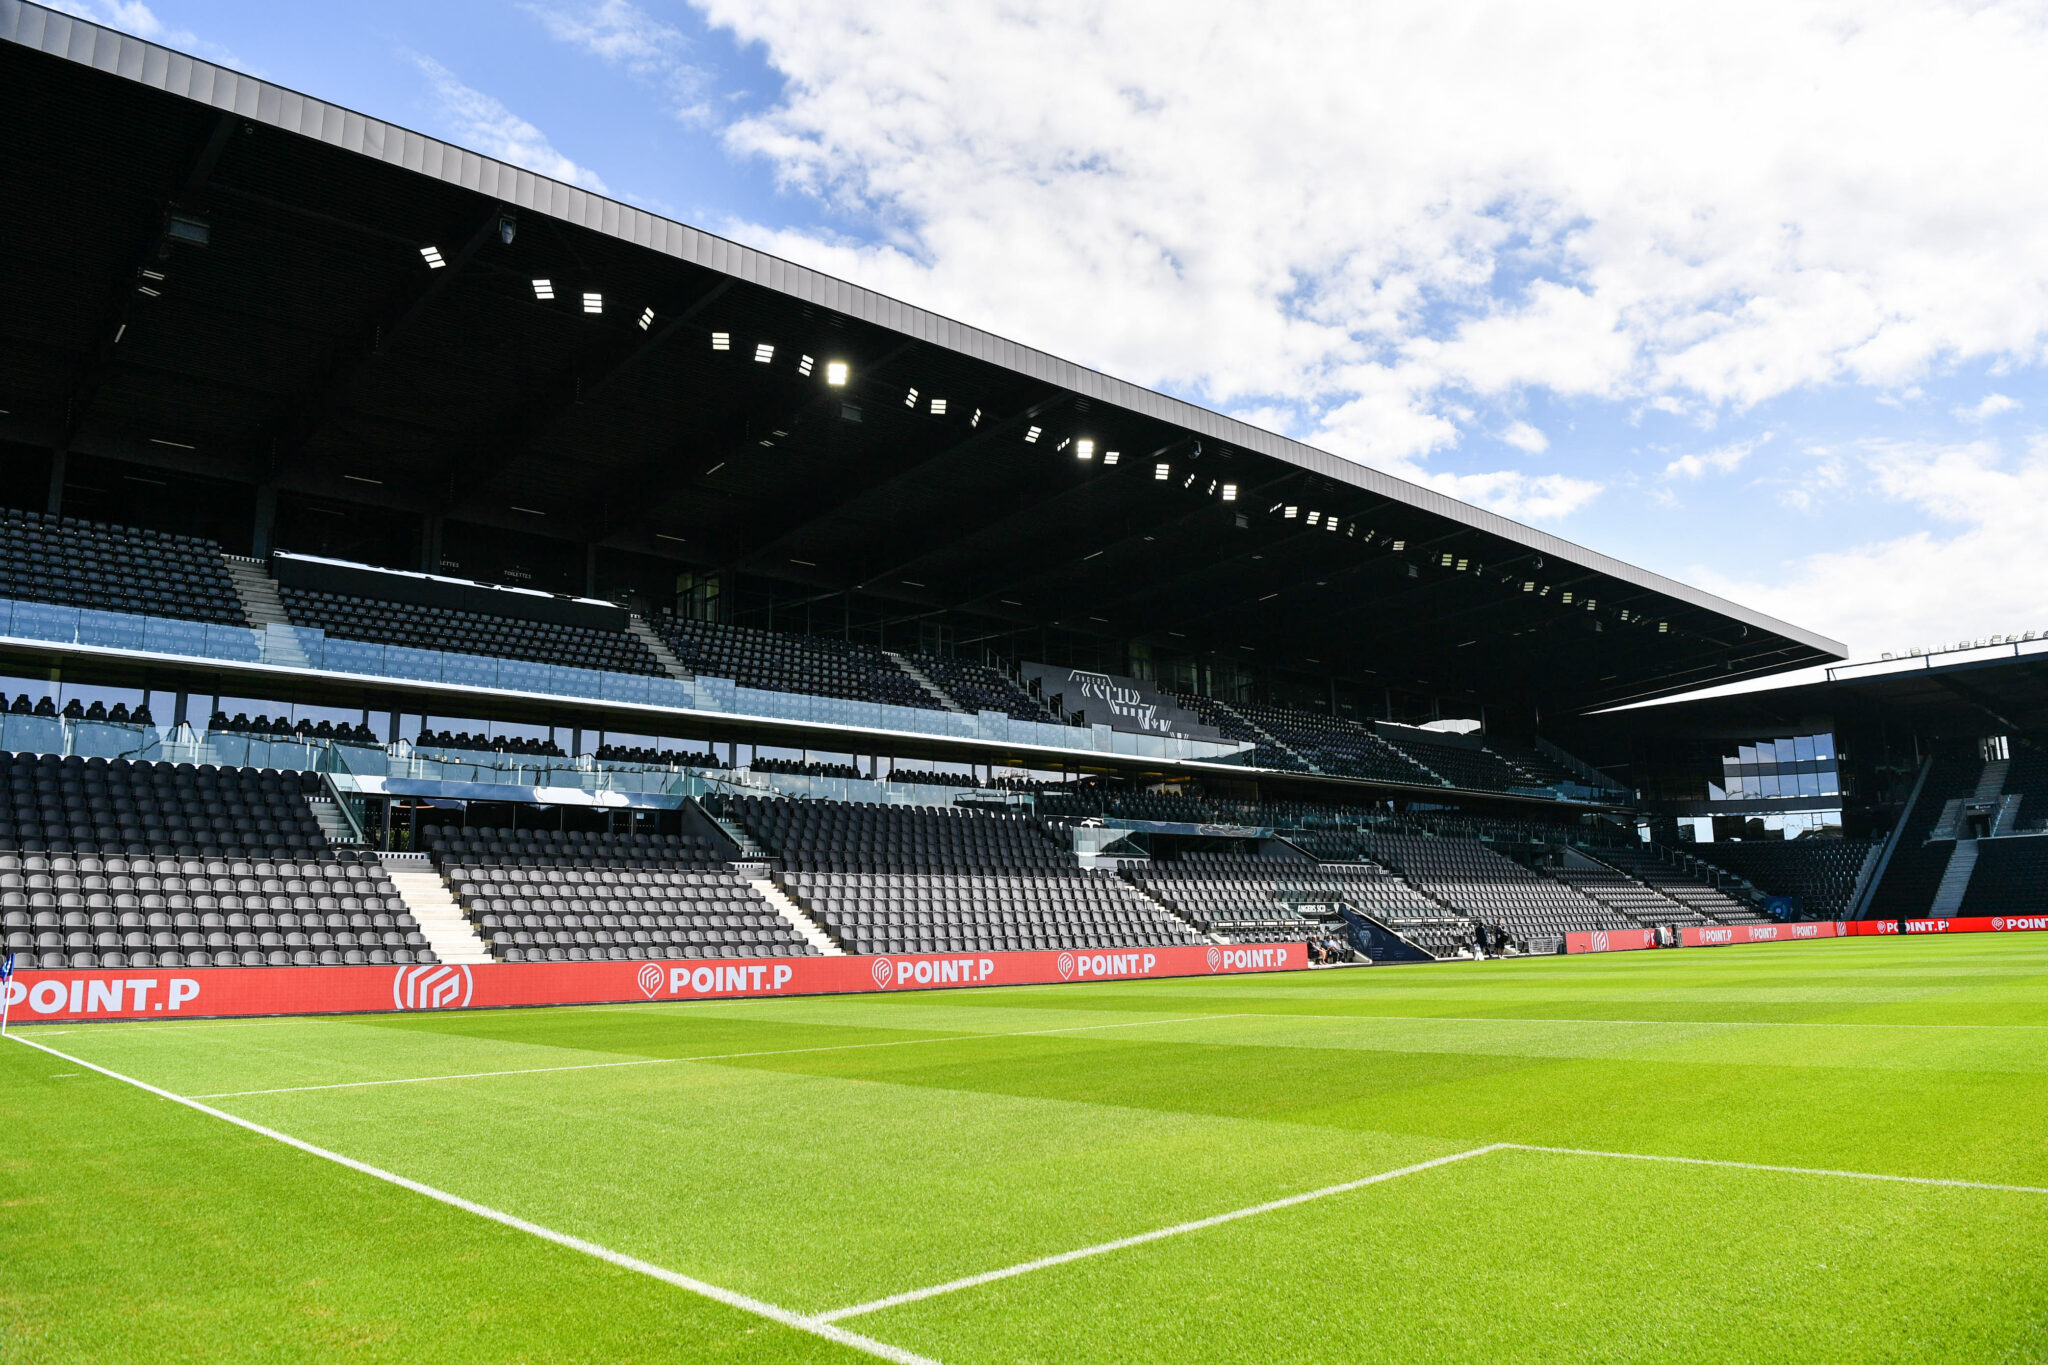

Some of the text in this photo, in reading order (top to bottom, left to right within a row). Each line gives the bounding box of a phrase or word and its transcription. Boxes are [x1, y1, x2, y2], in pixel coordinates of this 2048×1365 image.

[440, 560, 460, 568] LETTES
[504, 570, 532, 579] TOILETTES
[1297, 904, 1316, 913] ANGERS
[2006, 917, 2048, 930] POIN
[1705, 929, 1732, 942] POINT.P
[1753, 927, 1777, 939] POINT.P
[1796, 925, 1818, 937] POINT.P
[1078, 954, 1156, 976] POINT.P
[1223, 949, 1287, 968] POINT.P
[897, 959, 994, 984] POINT.P
[669, 965, 792, 994] POINT.P
[0, 979, 201, 1014] POINT.P
